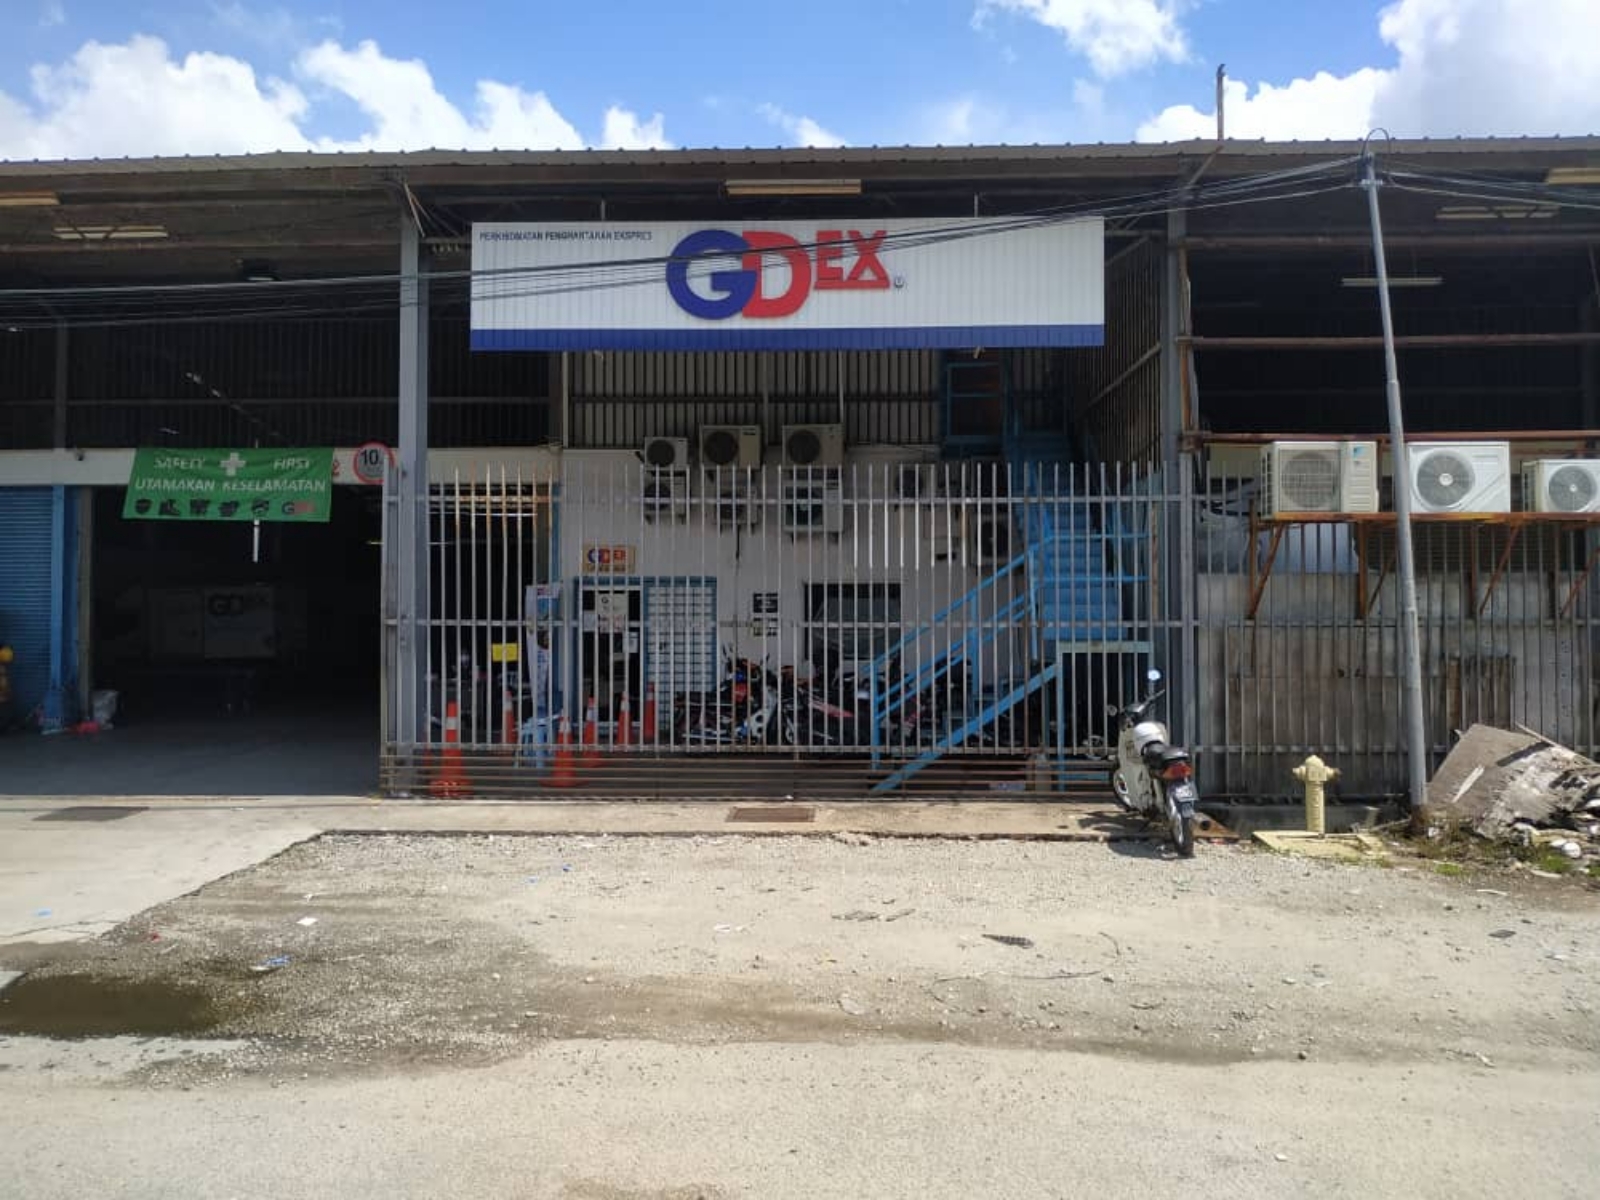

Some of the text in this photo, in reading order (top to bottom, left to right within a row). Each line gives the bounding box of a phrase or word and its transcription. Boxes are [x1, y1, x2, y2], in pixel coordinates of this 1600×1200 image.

[154, 457, 310, 471] SAFETY FIRST
[360, 449, 379, 466] 10
[135, 476, 326, 492] UTAMAKAN KESELAMATAN
